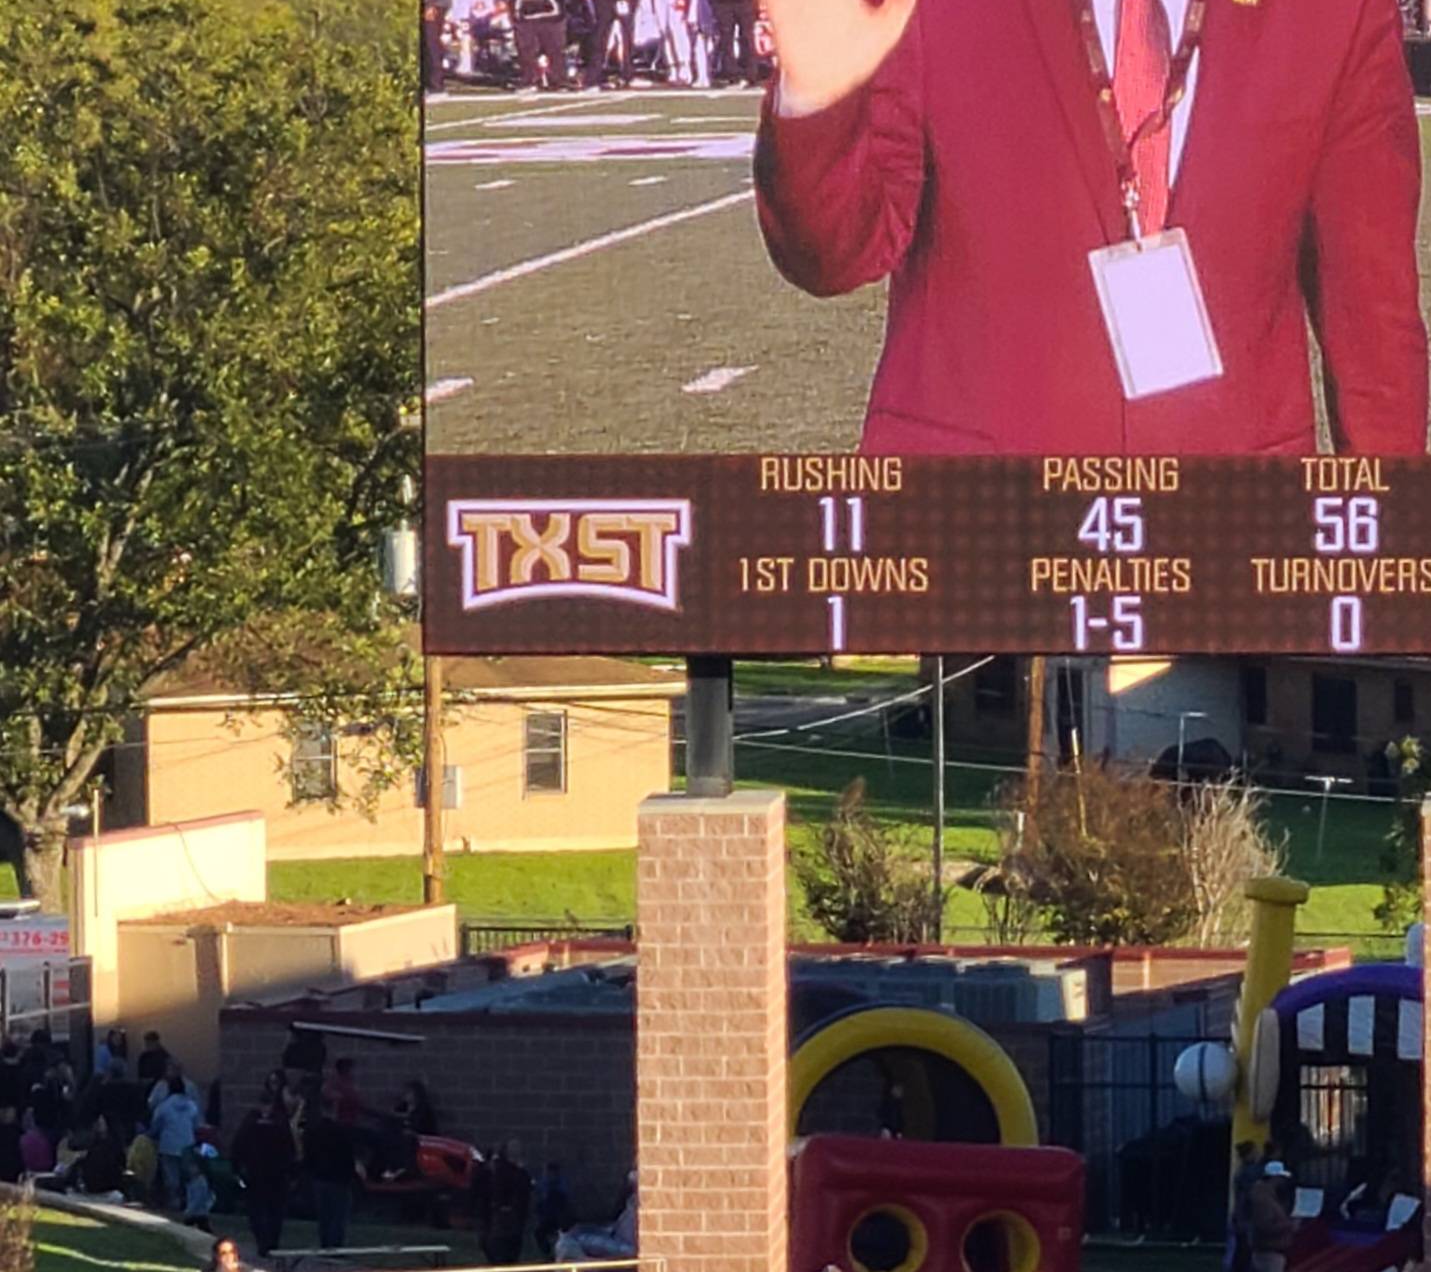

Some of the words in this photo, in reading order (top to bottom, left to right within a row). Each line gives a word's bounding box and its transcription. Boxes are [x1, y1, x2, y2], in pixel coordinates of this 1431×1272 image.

[761, 457, 902, 491] RUSHING
[1043, 457, 1180, 491] PASSING
[1300, 457, 1390, 491] TOTAL
[818, 496, 864, 551] 11
[1078, 496, 1143, 552] 45
[1314, 496, 1380, 552] 56
[461, 512, 678, 592] TXST
[739, 557, 794, 591] 1ST
[809, 557, 928, 592] DOWNS
[1031, 558, 1192, 592] PENALTIES
[826, 596, 846, 650] 1
[1069, 595, 1143, 651] 1-5
[1331, 596, 1361, 651] 0
